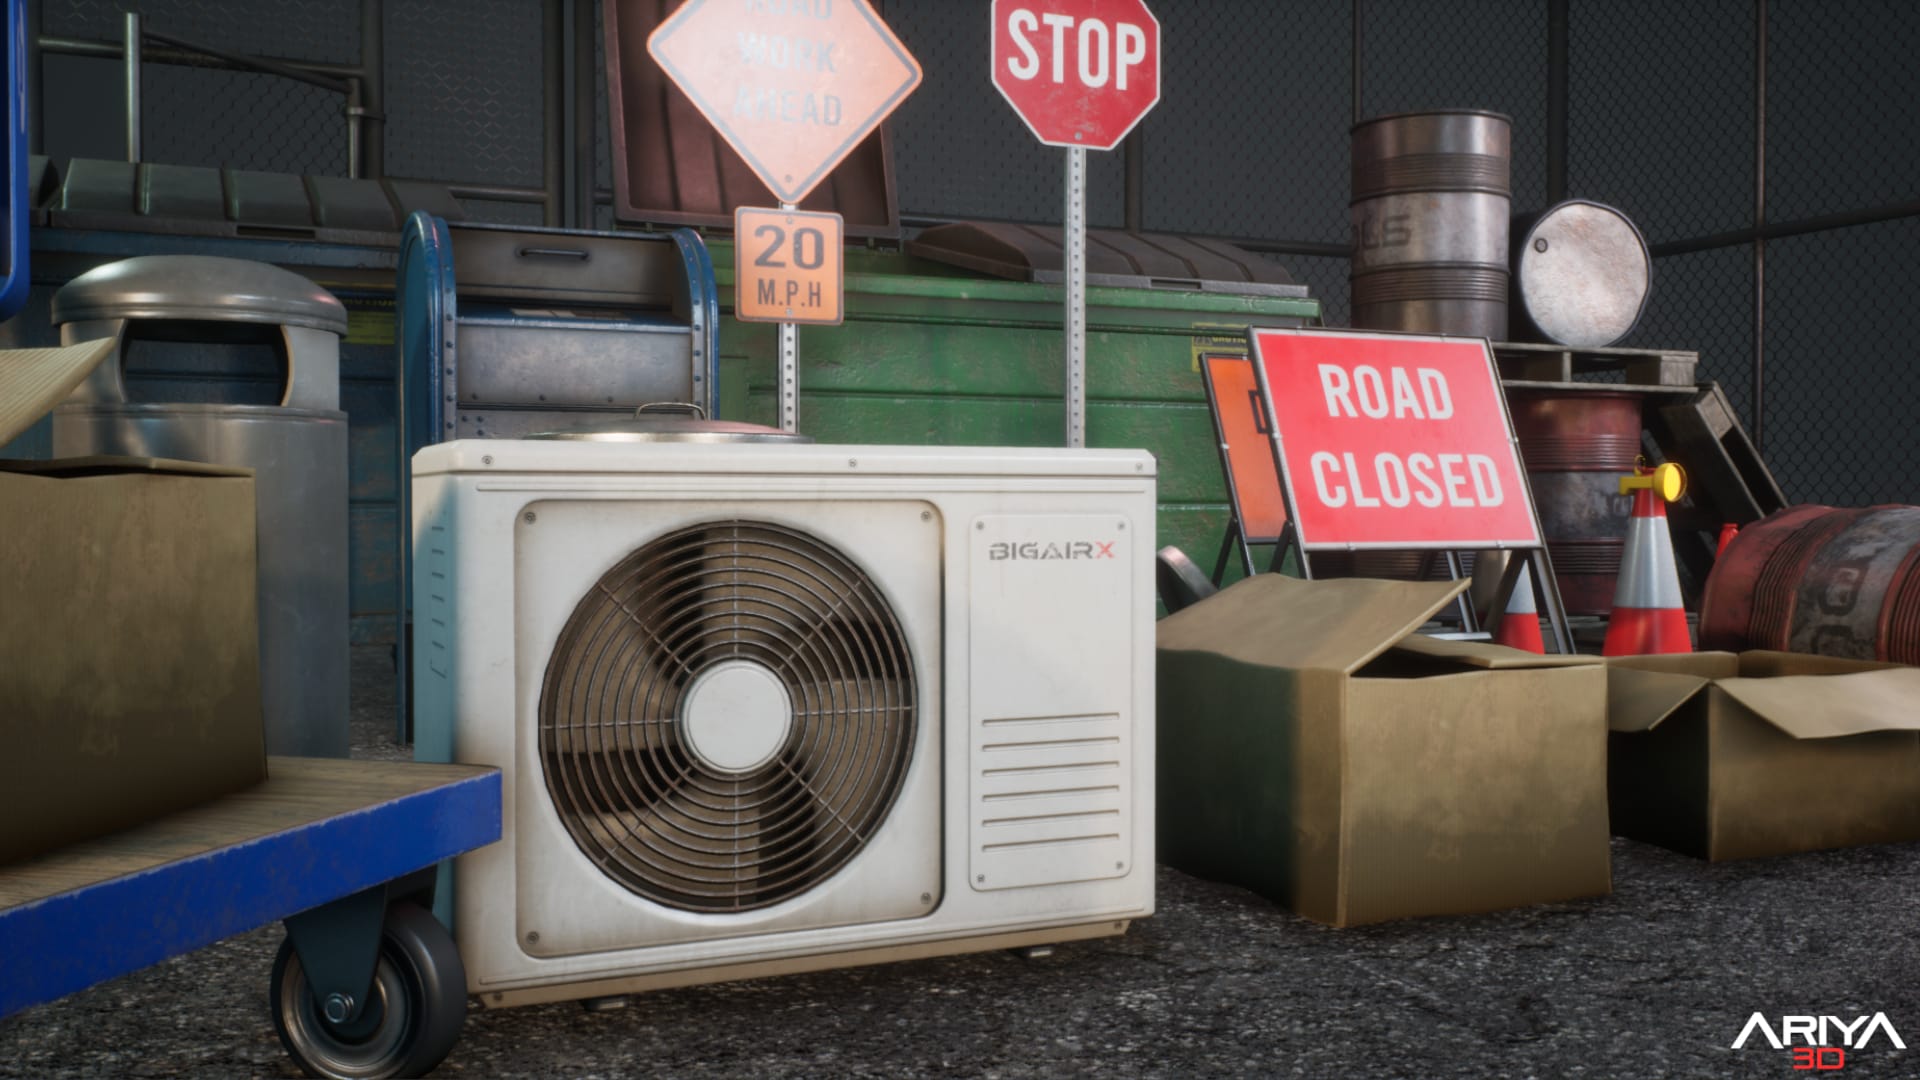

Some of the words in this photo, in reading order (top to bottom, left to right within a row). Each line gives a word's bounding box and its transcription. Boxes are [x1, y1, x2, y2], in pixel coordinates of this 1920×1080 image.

[737, 31, 836, 73] WORK
[1008, 8, 1146, 90] STOP
[734, 86, 842, 126] AHEAD
[754, 224, 824, 270] 20
[757, 278, 821, 307] M.P.H
[1317, 363, 1454, 420] ROAD
[1310, 451, 1504, 508] CLOSED
[989, 541, 1115, 560] BIGAIRX
